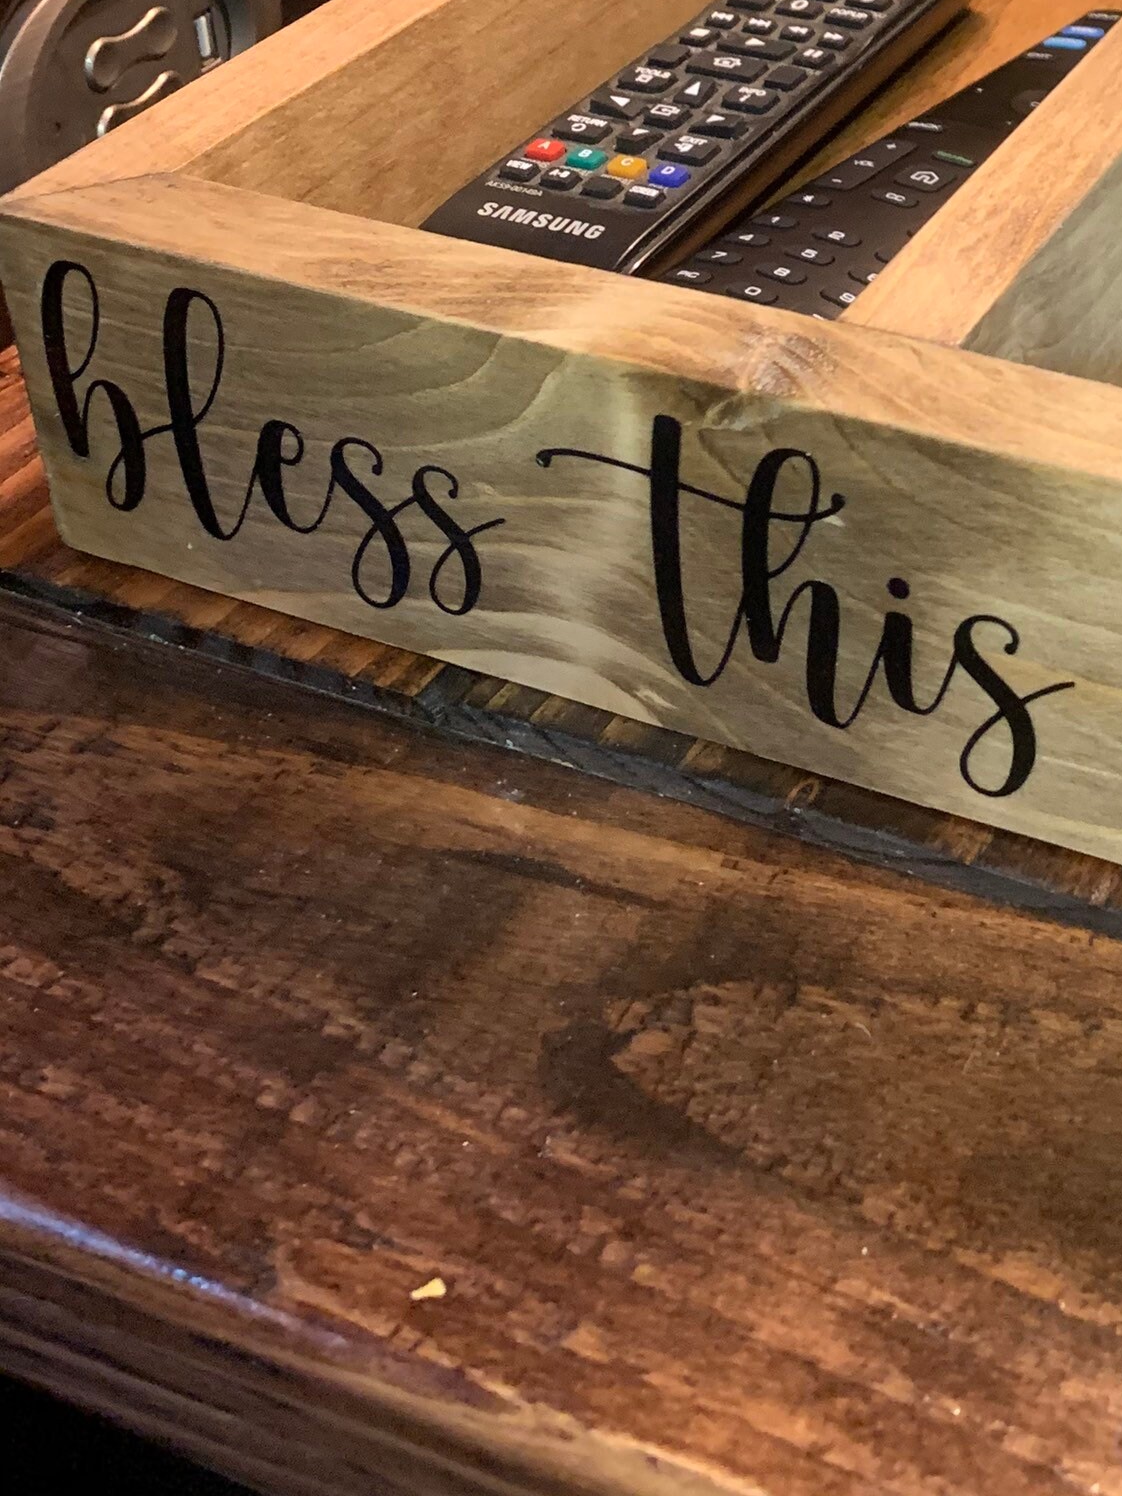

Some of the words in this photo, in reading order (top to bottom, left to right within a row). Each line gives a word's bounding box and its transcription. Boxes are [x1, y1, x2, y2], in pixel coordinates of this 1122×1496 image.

[635, 66, 672, 79] TOOLS
[567, 114, 608, 128] RETURN
[537, 140, 551, 150] A
[678, 135, 708, 146] EXIT
[577, 149, 593, 158] B
[506, 159, 533, 170] VIEW
[620, 157, 634, 166] C
[660, 165, 676, 175] D
[885, 192, 906, 202] CC
[477, 202, 606, 239] SAMSUNG
[771, 216, 781, 224] 1
[827, 230, 846, 241] 2
[711, 251, 728, 259] 7
[800, 248, 818, 259] 5
[773, 267, 791, 277] 8
[744, 286, 762, 296] 0
[839, 292, 856, 303] 9
[41, 259, 506, 616] bless
[536, 414, 1076, 798] this
